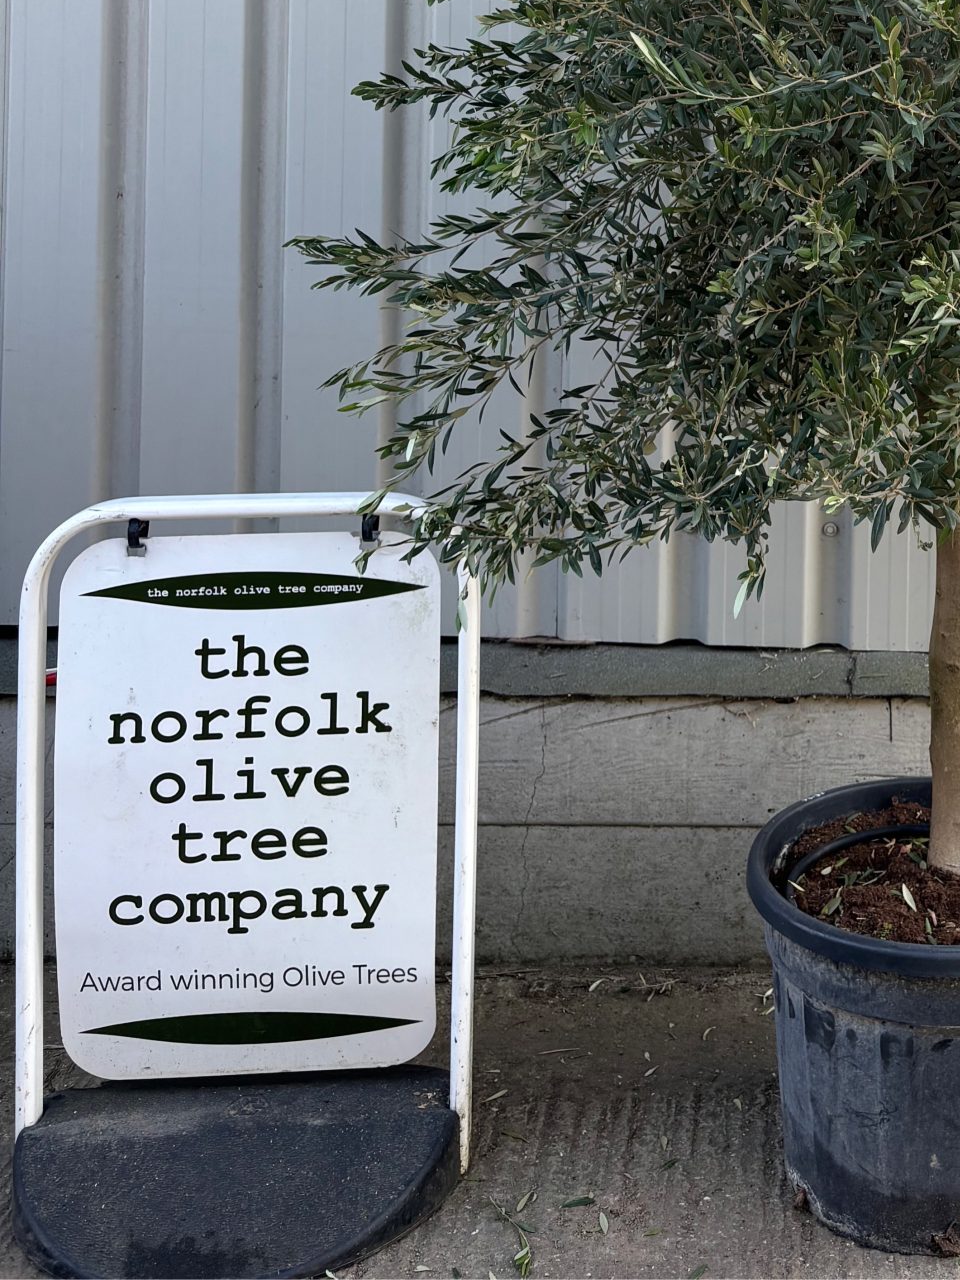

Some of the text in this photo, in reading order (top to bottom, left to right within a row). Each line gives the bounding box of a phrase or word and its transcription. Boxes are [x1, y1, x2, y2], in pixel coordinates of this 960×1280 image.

[147, 583, 364, 598] the norfolk olive tree company
[195, 635, 310, 679] the
[108, 691, 393, 744] norfolk
[149, 756, 350, 804] olive
[172, 823, 328, 864] tree
[108, 883, 390, 934] company
[79, 963, 418, 993] Award winning Olive Trees
